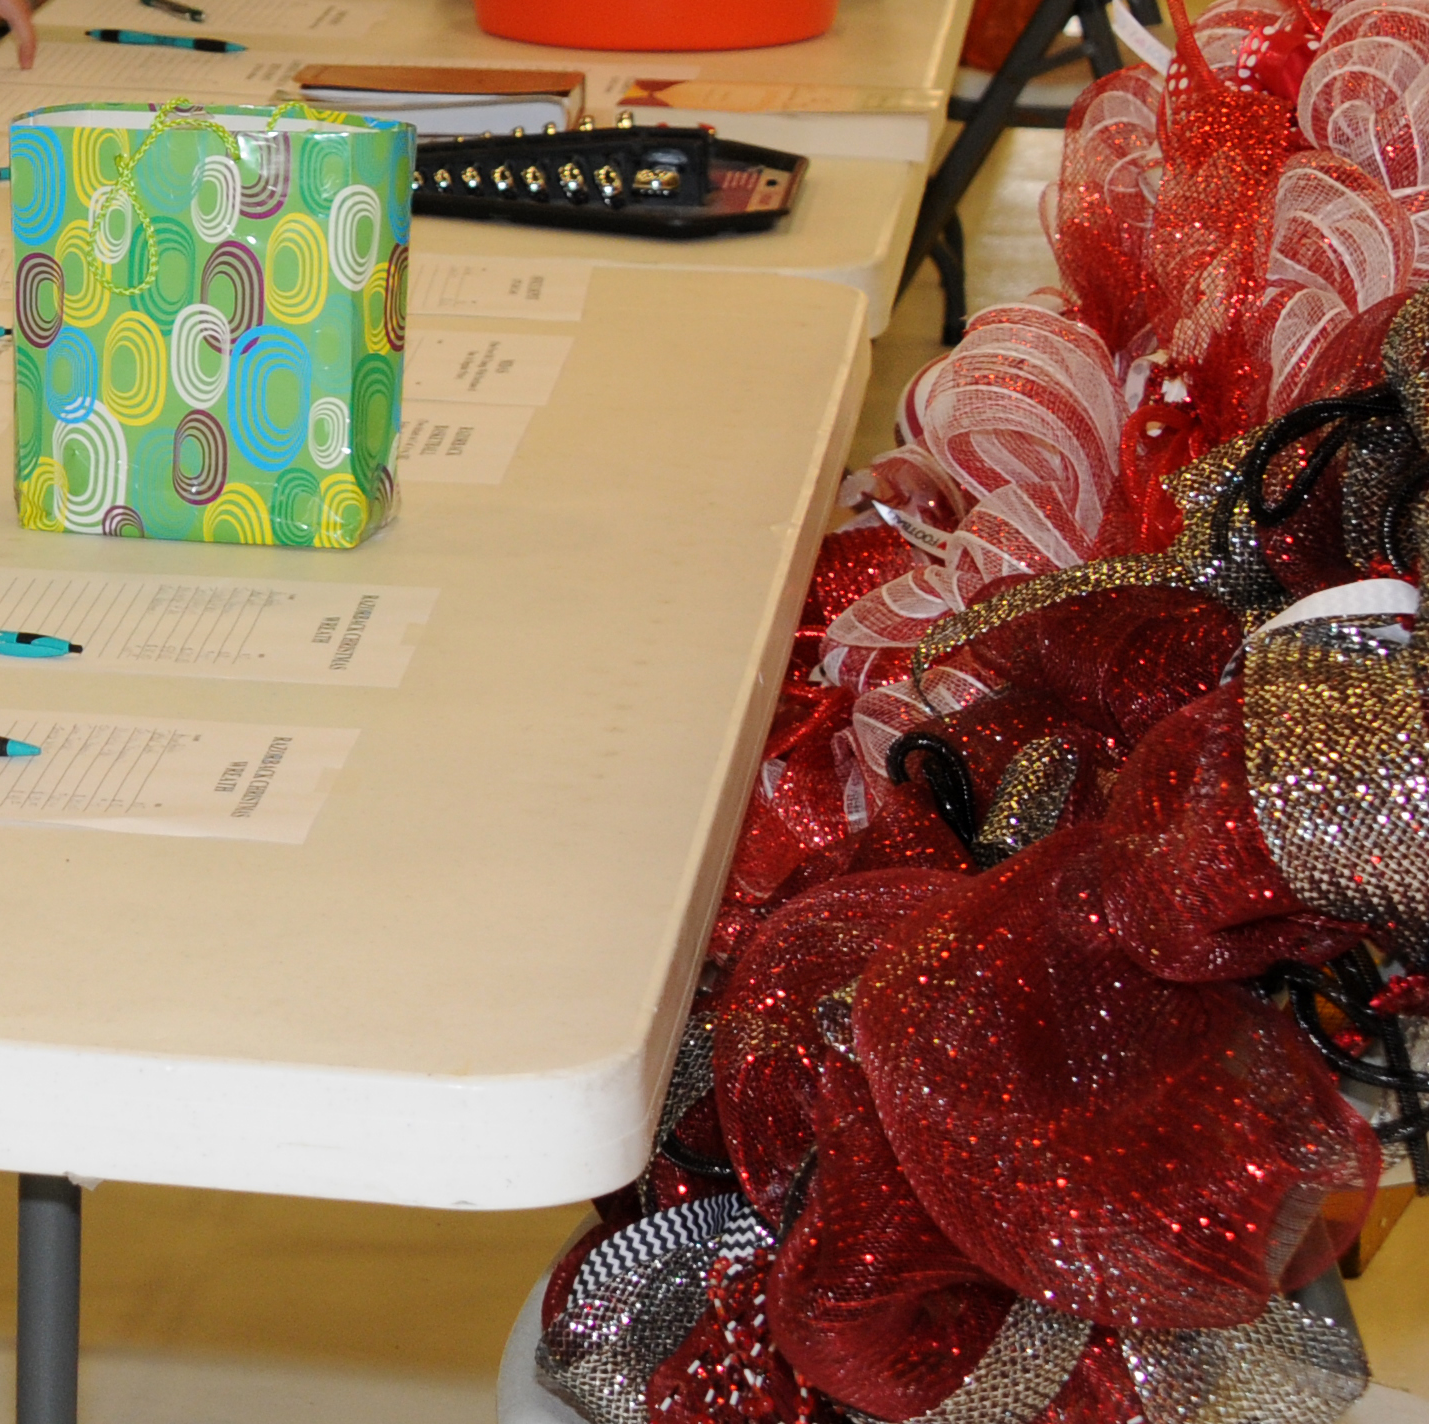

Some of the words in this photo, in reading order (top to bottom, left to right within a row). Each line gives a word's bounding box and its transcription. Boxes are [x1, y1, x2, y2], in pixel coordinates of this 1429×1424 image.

[310, 616, 341, 643] WREATH
[346, 594, 380, 632] RAZORBACK
[328, 632, 362, 670] CHRISTMAS
[213, 761, 249, 792] WREATH
[253, 736, 293, 779] RAZORBACK
[230, 779, 270, 818] CHRISTMAS
